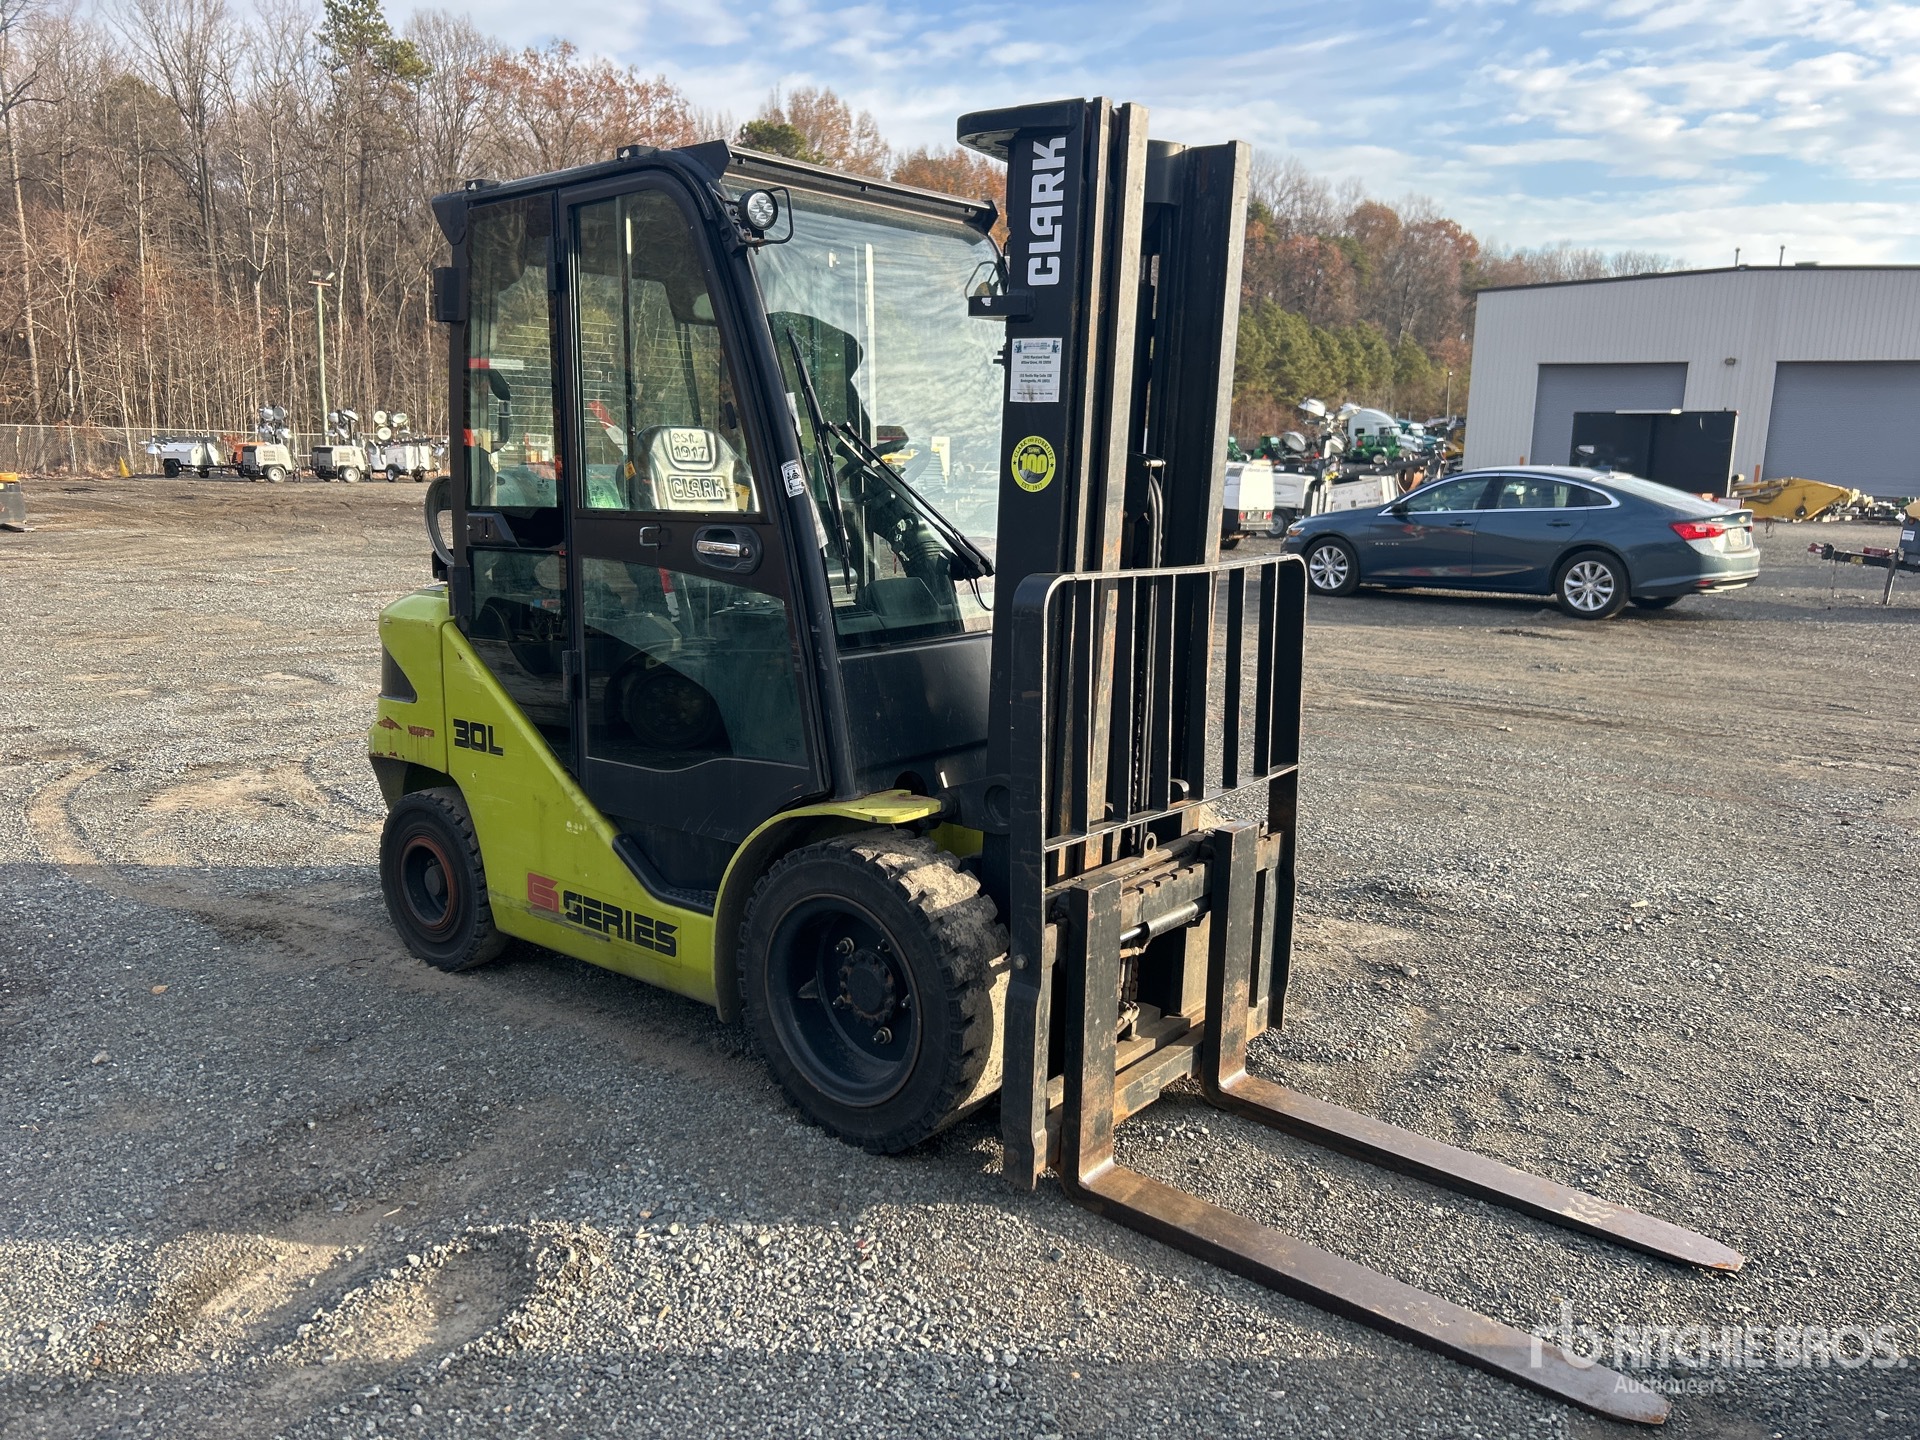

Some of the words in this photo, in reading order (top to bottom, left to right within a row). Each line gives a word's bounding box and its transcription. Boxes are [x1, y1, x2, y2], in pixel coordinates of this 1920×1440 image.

[1027, 136, 1067, 286] CLARK
[674, 445, 707, 460] 1917
[1014, 441, 1027, 457] CLARK
[1020, 453, 1048, 474] 100
[670, 478, 725, 499] CLARK
[453, 718, 504, 757] 30L
[563, 889, 679, 958] SERIES
